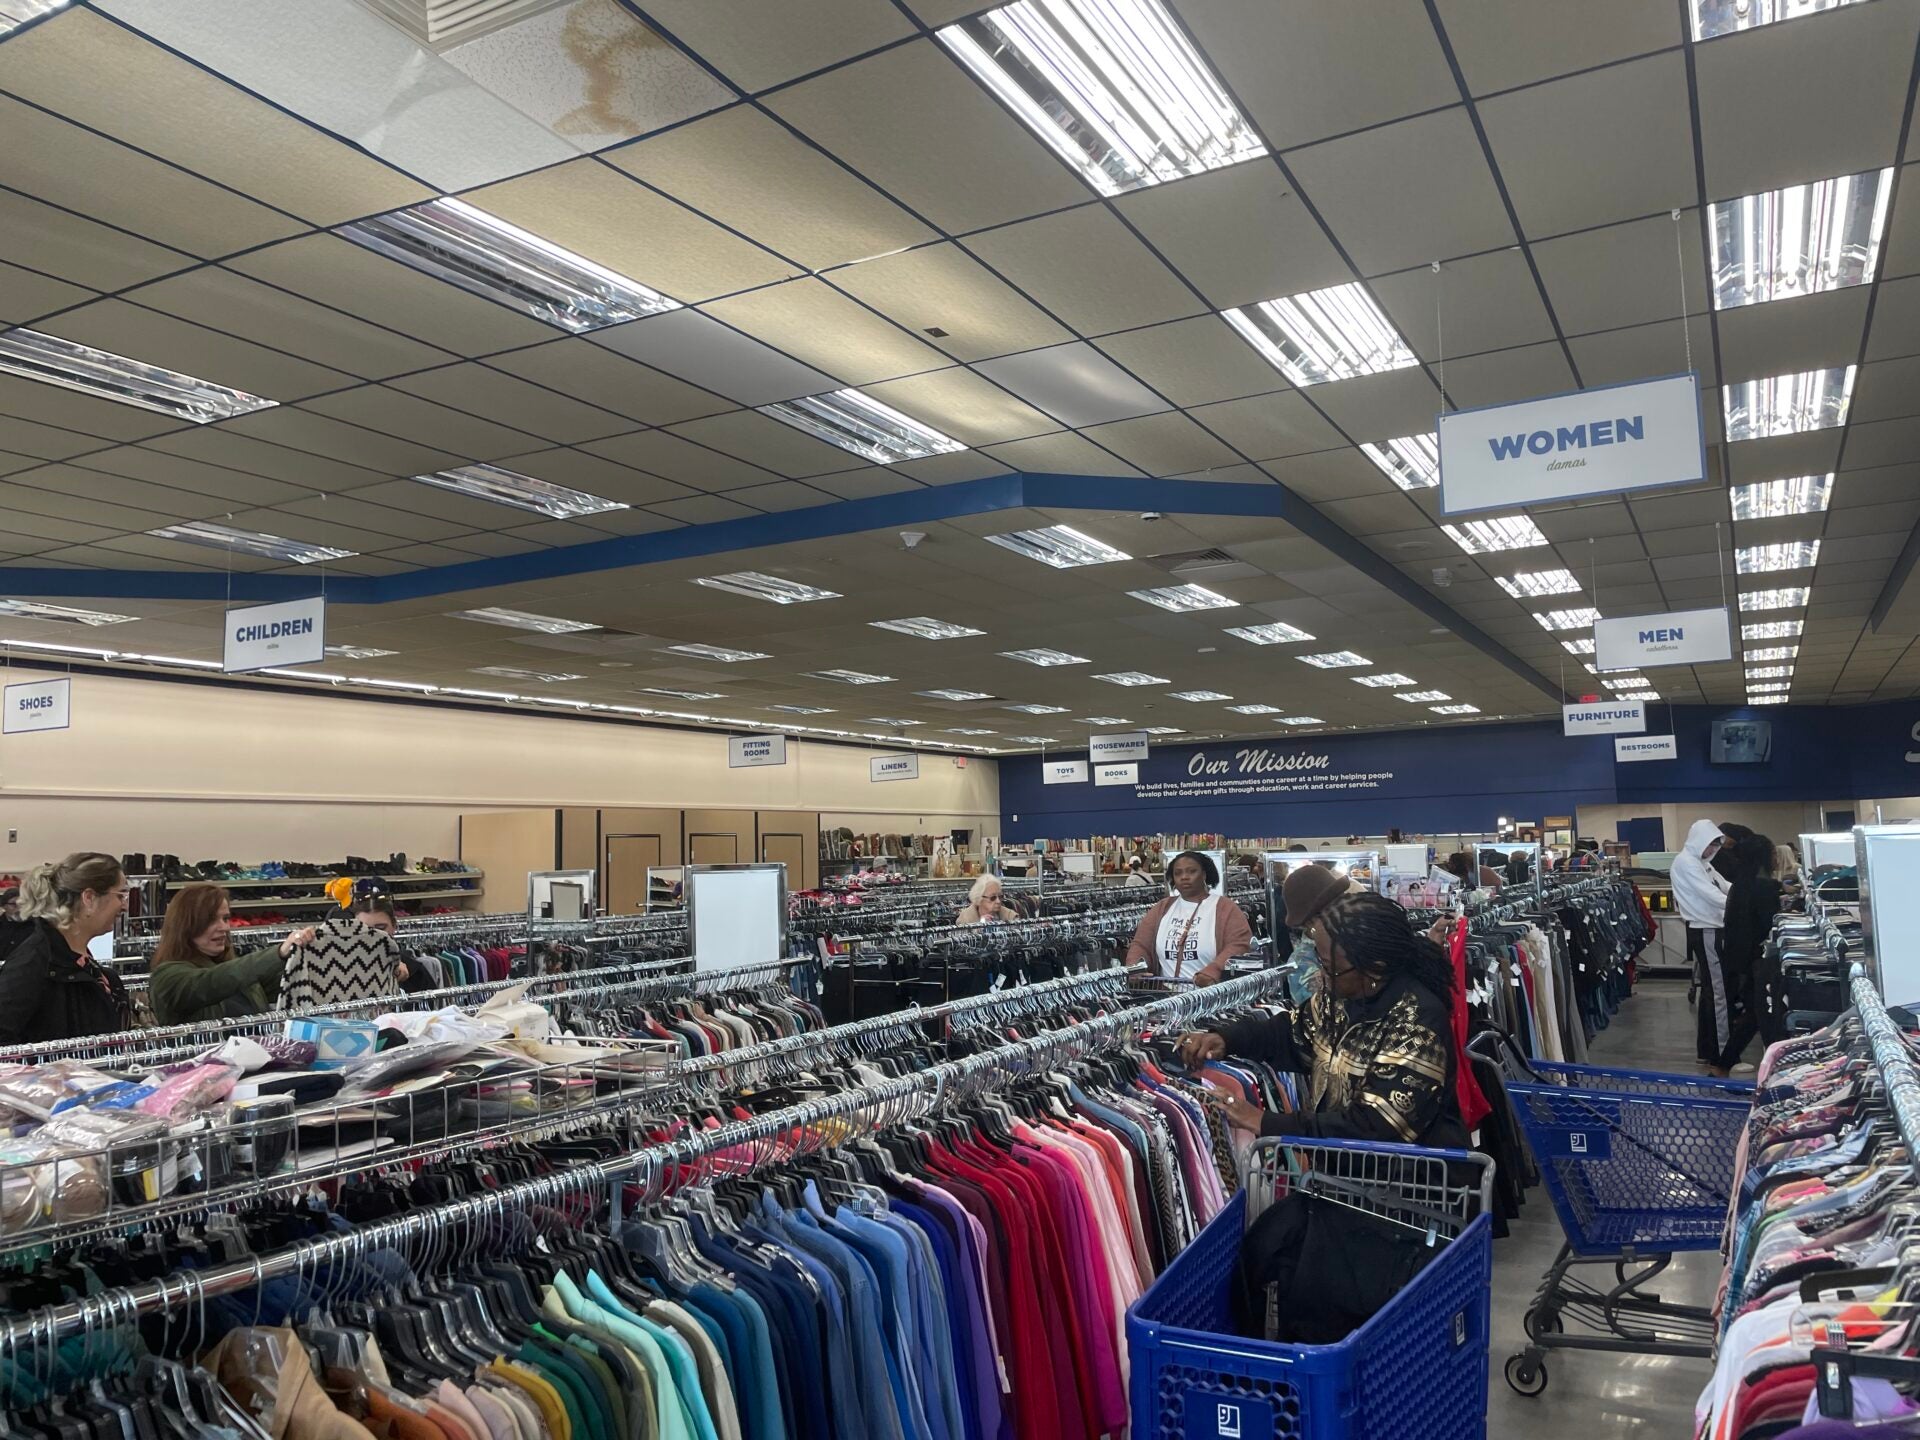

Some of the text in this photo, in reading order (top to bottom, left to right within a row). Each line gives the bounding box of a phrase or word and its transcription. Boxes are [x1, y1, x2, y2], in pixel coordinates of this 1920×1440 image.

[1488, 415, 1645, 461] WOMEN
[1546, 457, 1588, 472] damas
[236, 617, 313, 642] CHILDREN
[1638, 627, 1684, 643] MEN
[19, 696, 53, 711] SHOES
[1568, 709, 1640, 722] FURNITURE
[742, 741, 771, 749] FITTING
[1092, 740, 1146, 750] HOUSEWARES
[1621, 742, 1671, 751] RESTROOMS
[743, 749, 770, 757] ROOMS
[881, 762, 908, 771] LINENS
[1187, 748, 1330, 776] Our Mission
[1219, 778, 1261, 786] communities
[1312, 773, 1329, 781] time
[1330, 773, 1339, 782] by
[1340, 772, 1367, 781] helping
[1368, 771, 1394, 780] people
[1213, 787, 1228, 796] gifts
[1228, 785, 1255, 794] through
[1310, 782, 1324, 790] and
[1171, 939, 1198, 951] NED
[1168, 950, 1195, 961] JEUS
